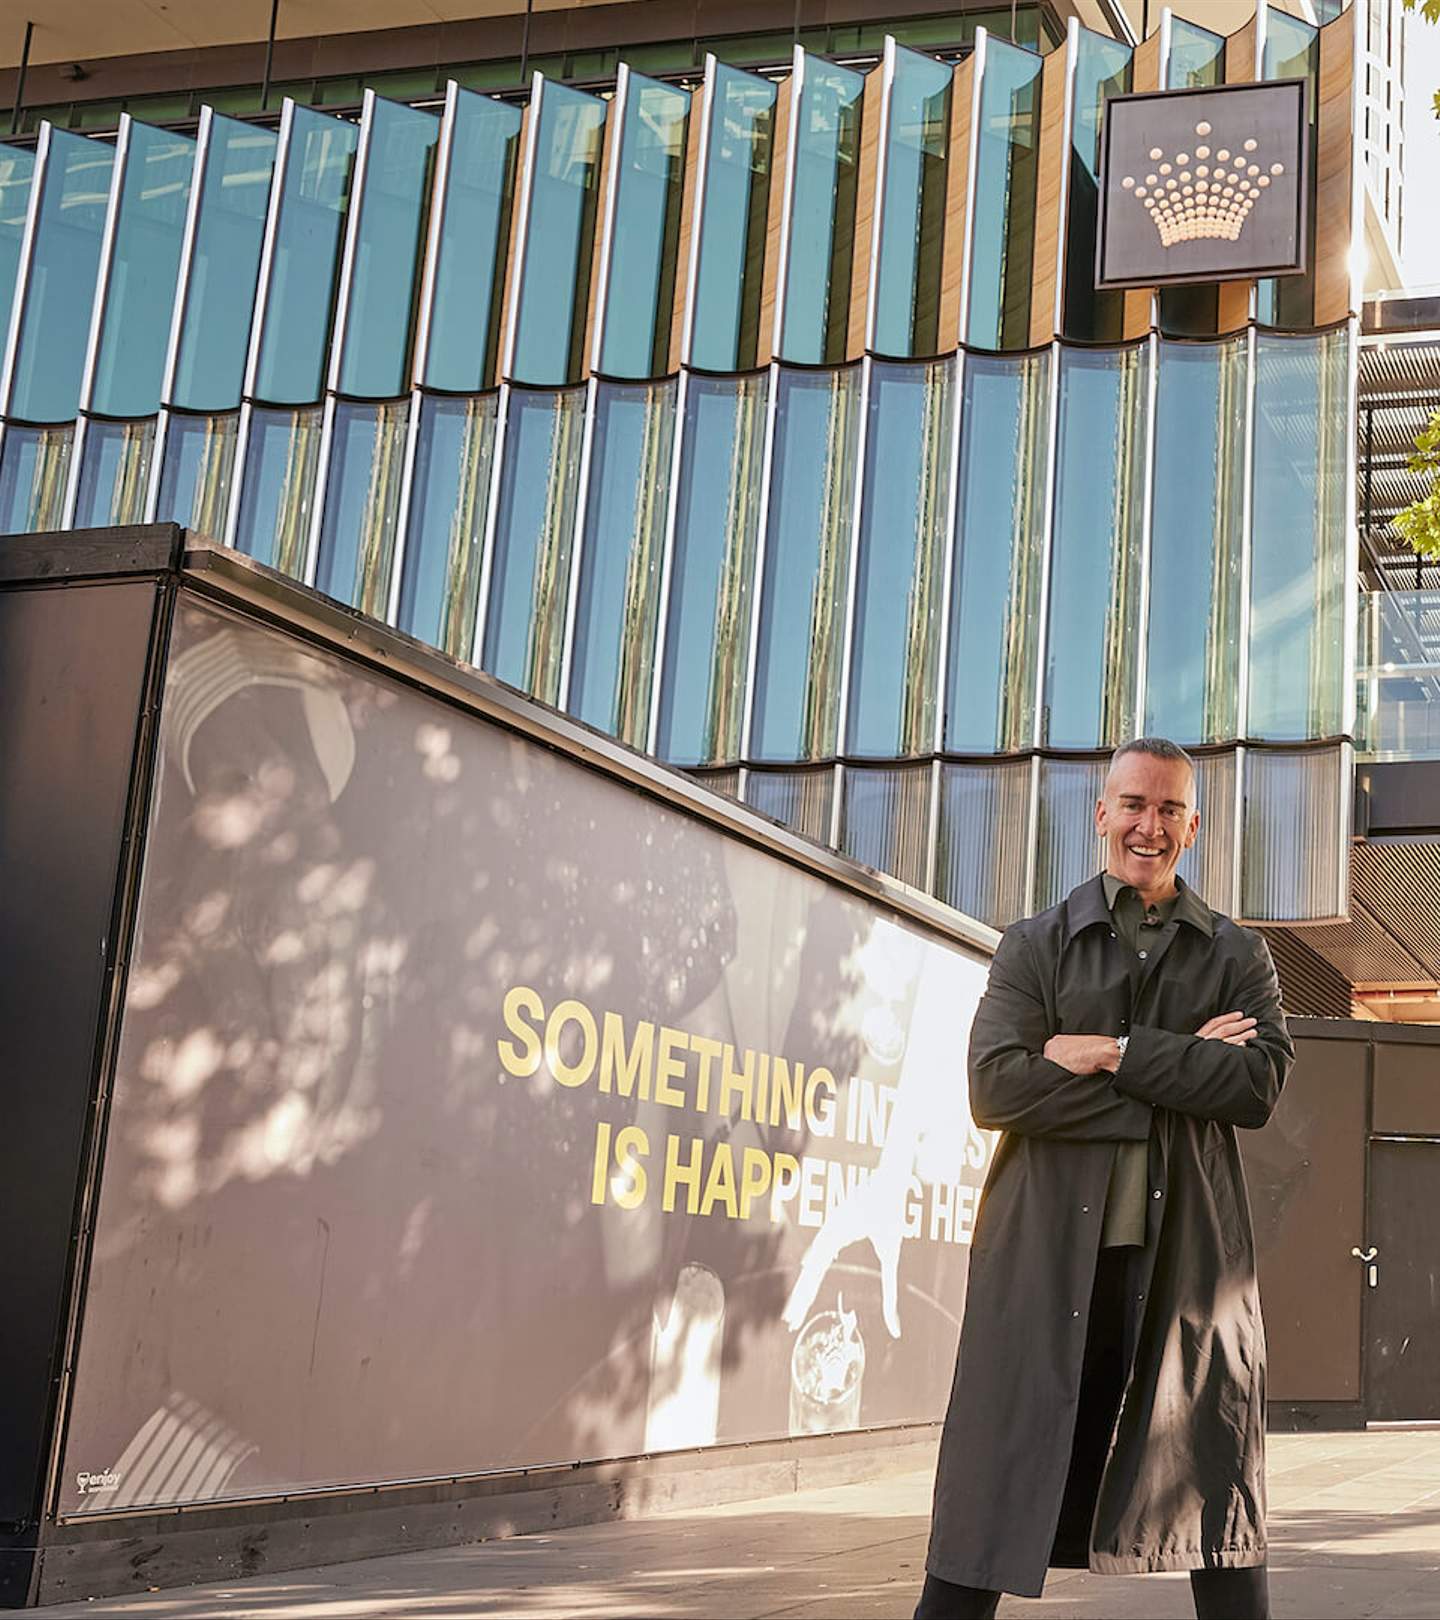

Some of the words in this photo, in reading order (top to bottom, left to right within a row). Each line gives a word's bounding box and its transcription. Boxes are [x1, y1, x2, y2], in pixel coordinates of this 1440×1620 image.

[497, 985, 836, 1138] SOMETHING
[591, 1122, 649, 1211] IS
[662, 1134, 923, 1239] HAPPENG
[929, 1182, 983, 1244] HE
[89, 1468, 120, 1487] enjoy
